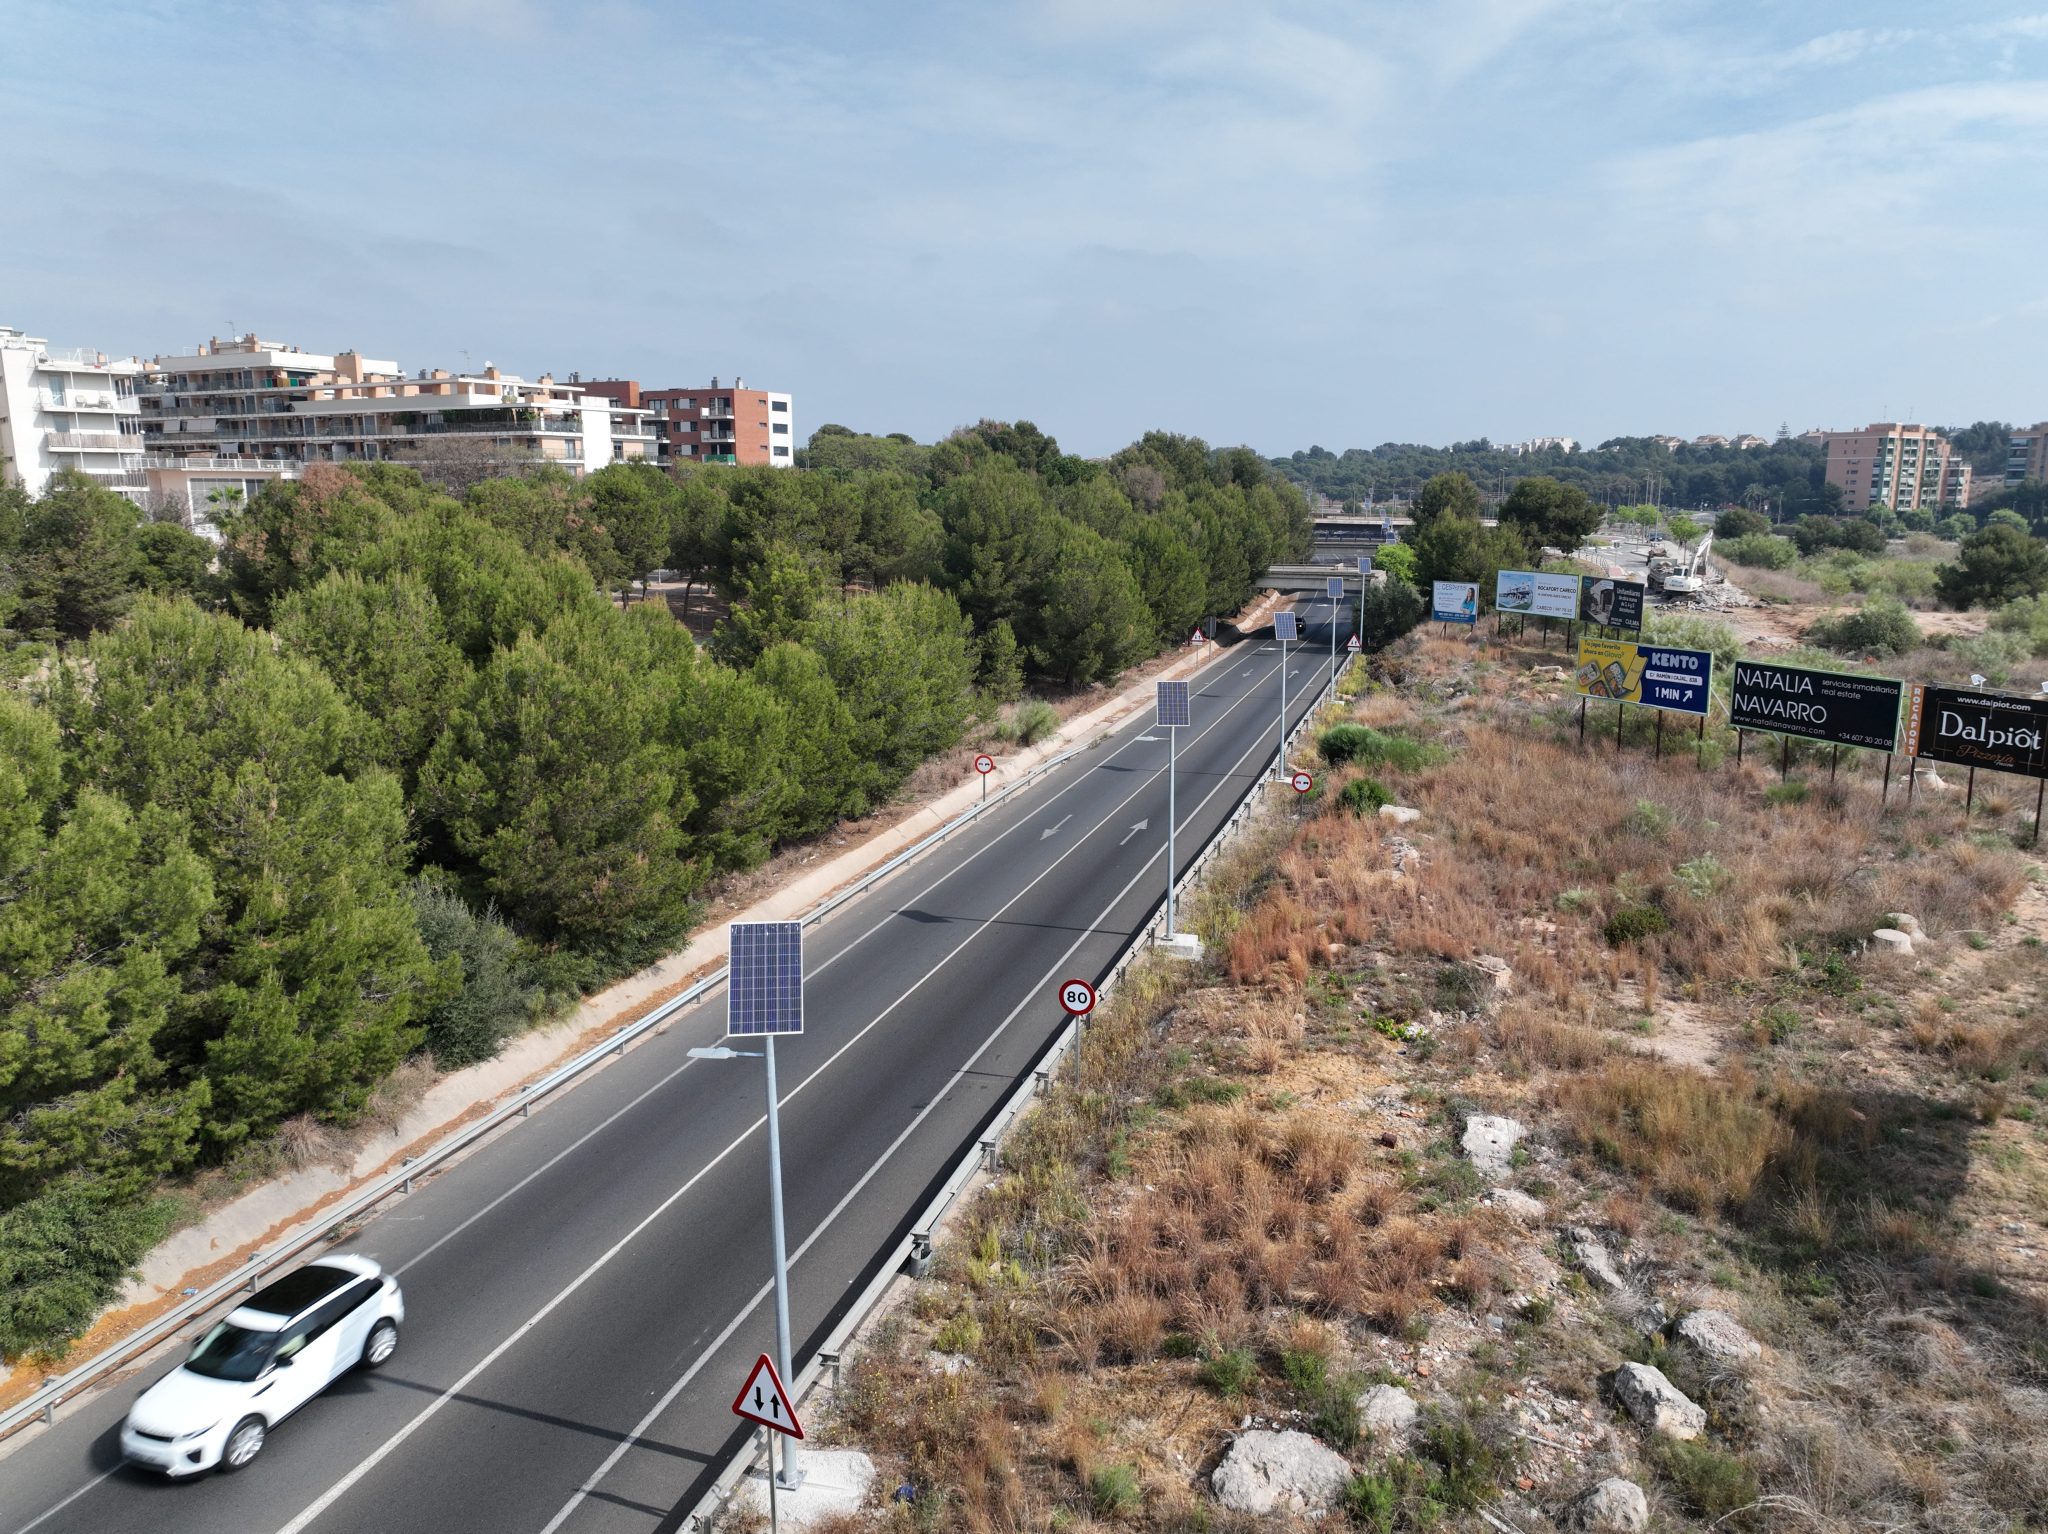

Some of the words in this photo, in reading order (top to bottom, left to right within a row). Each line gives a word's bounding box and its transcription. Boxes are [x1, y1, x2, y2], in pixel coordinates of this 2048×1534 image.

[1651, 652, 1699, 670] KENTO
[1736, 667, 1814, 696] NATALIA
[1822, 679, 1852, 689] servicios
[1852, 682, 1898, 695] inmobiliarios
[1655, 686, 1660, 698] 1
[1661, 687, 1680, 701] MIN
[1821, 688, 1836, 696] real
[1837, 690, 1861, 700] estate
[1734, 692, 1827, 724] NAVARRO
[1957, 696, 2031, 712] www.dalpiot.com
[1733, 714, 1826, 735] www.natalianavarro.com
[1908, 687, 1921, 754] ROCAFORT
[1939, 710, 2042, 750] Dalpiôt
[1838, 732, 1850, 740] +34
[1874, 737, 1883, 745] 20
[1883, 739, 1893, 747] 08
[1067, 991, 1088, 1004] 80
